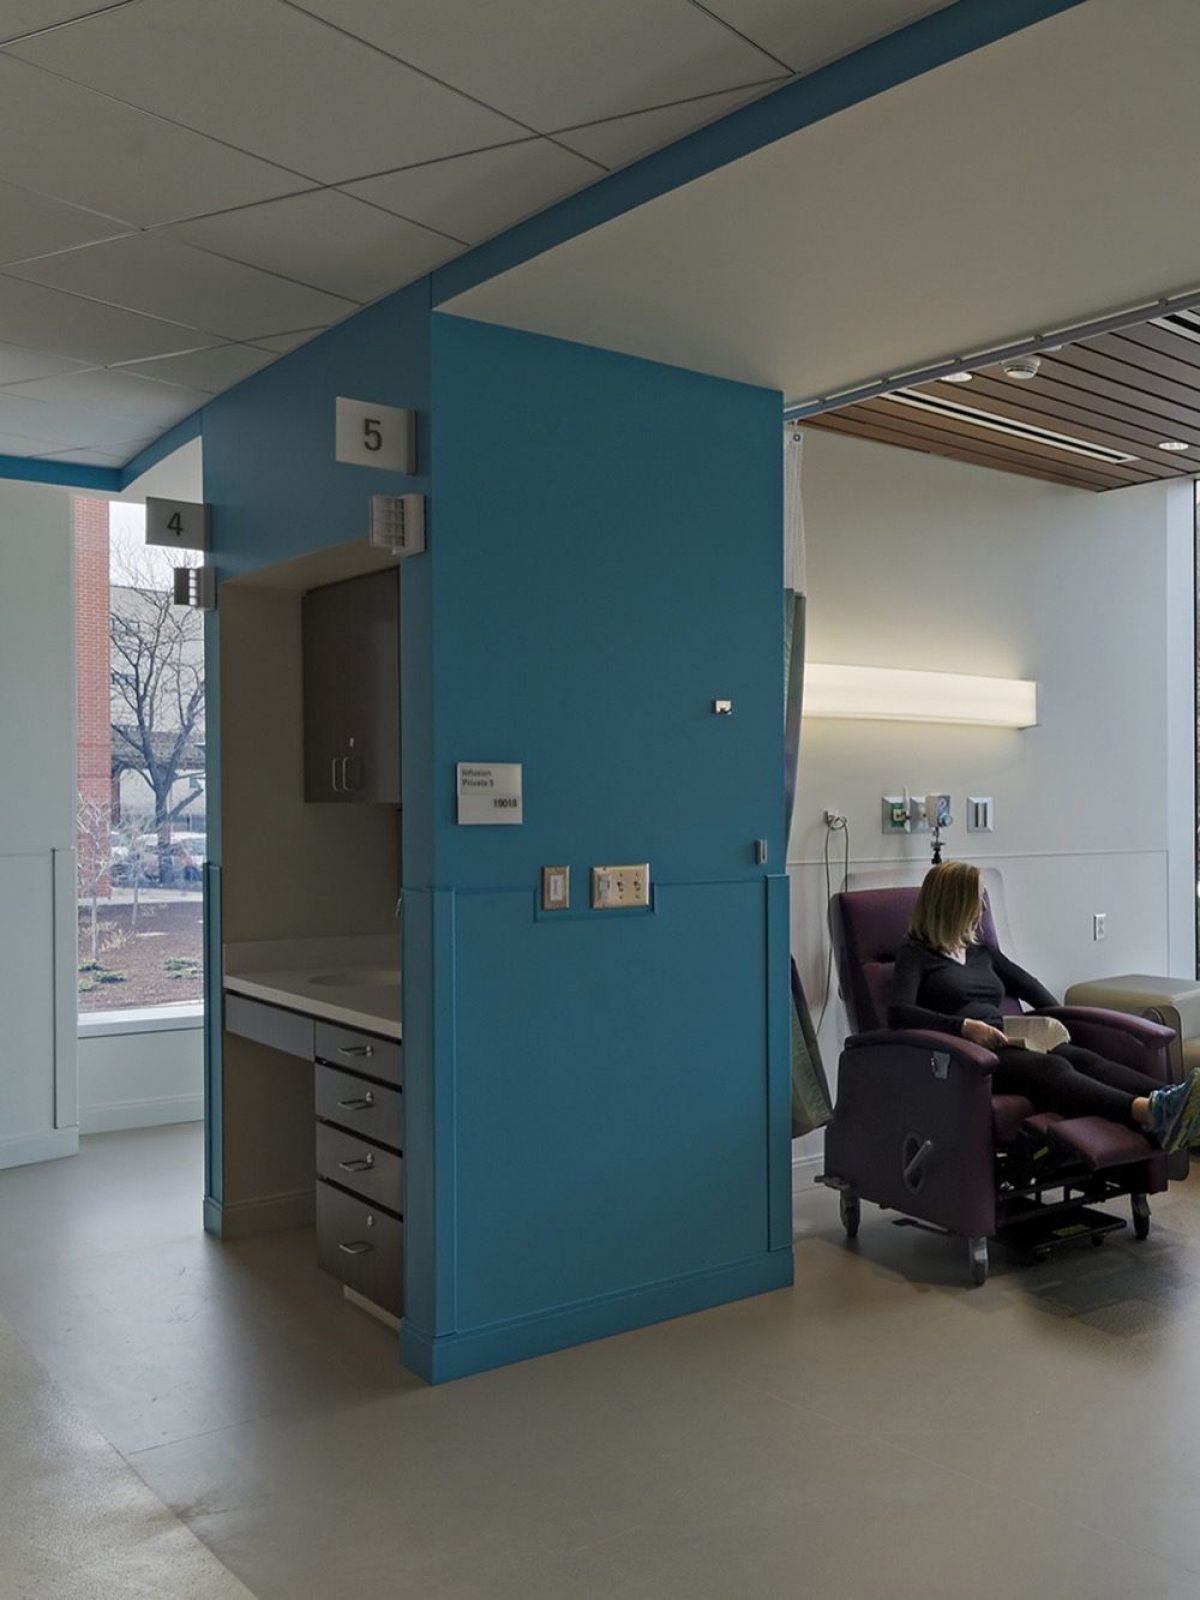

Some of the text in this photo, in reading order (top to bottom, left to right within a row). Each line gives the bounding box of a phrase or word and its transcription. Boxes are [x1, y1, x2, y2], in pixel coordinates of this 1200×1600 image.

[364, 418, 382, 451] 5
[167, 512, 183, 536] 4
[462, 778, 487, 787] Private
